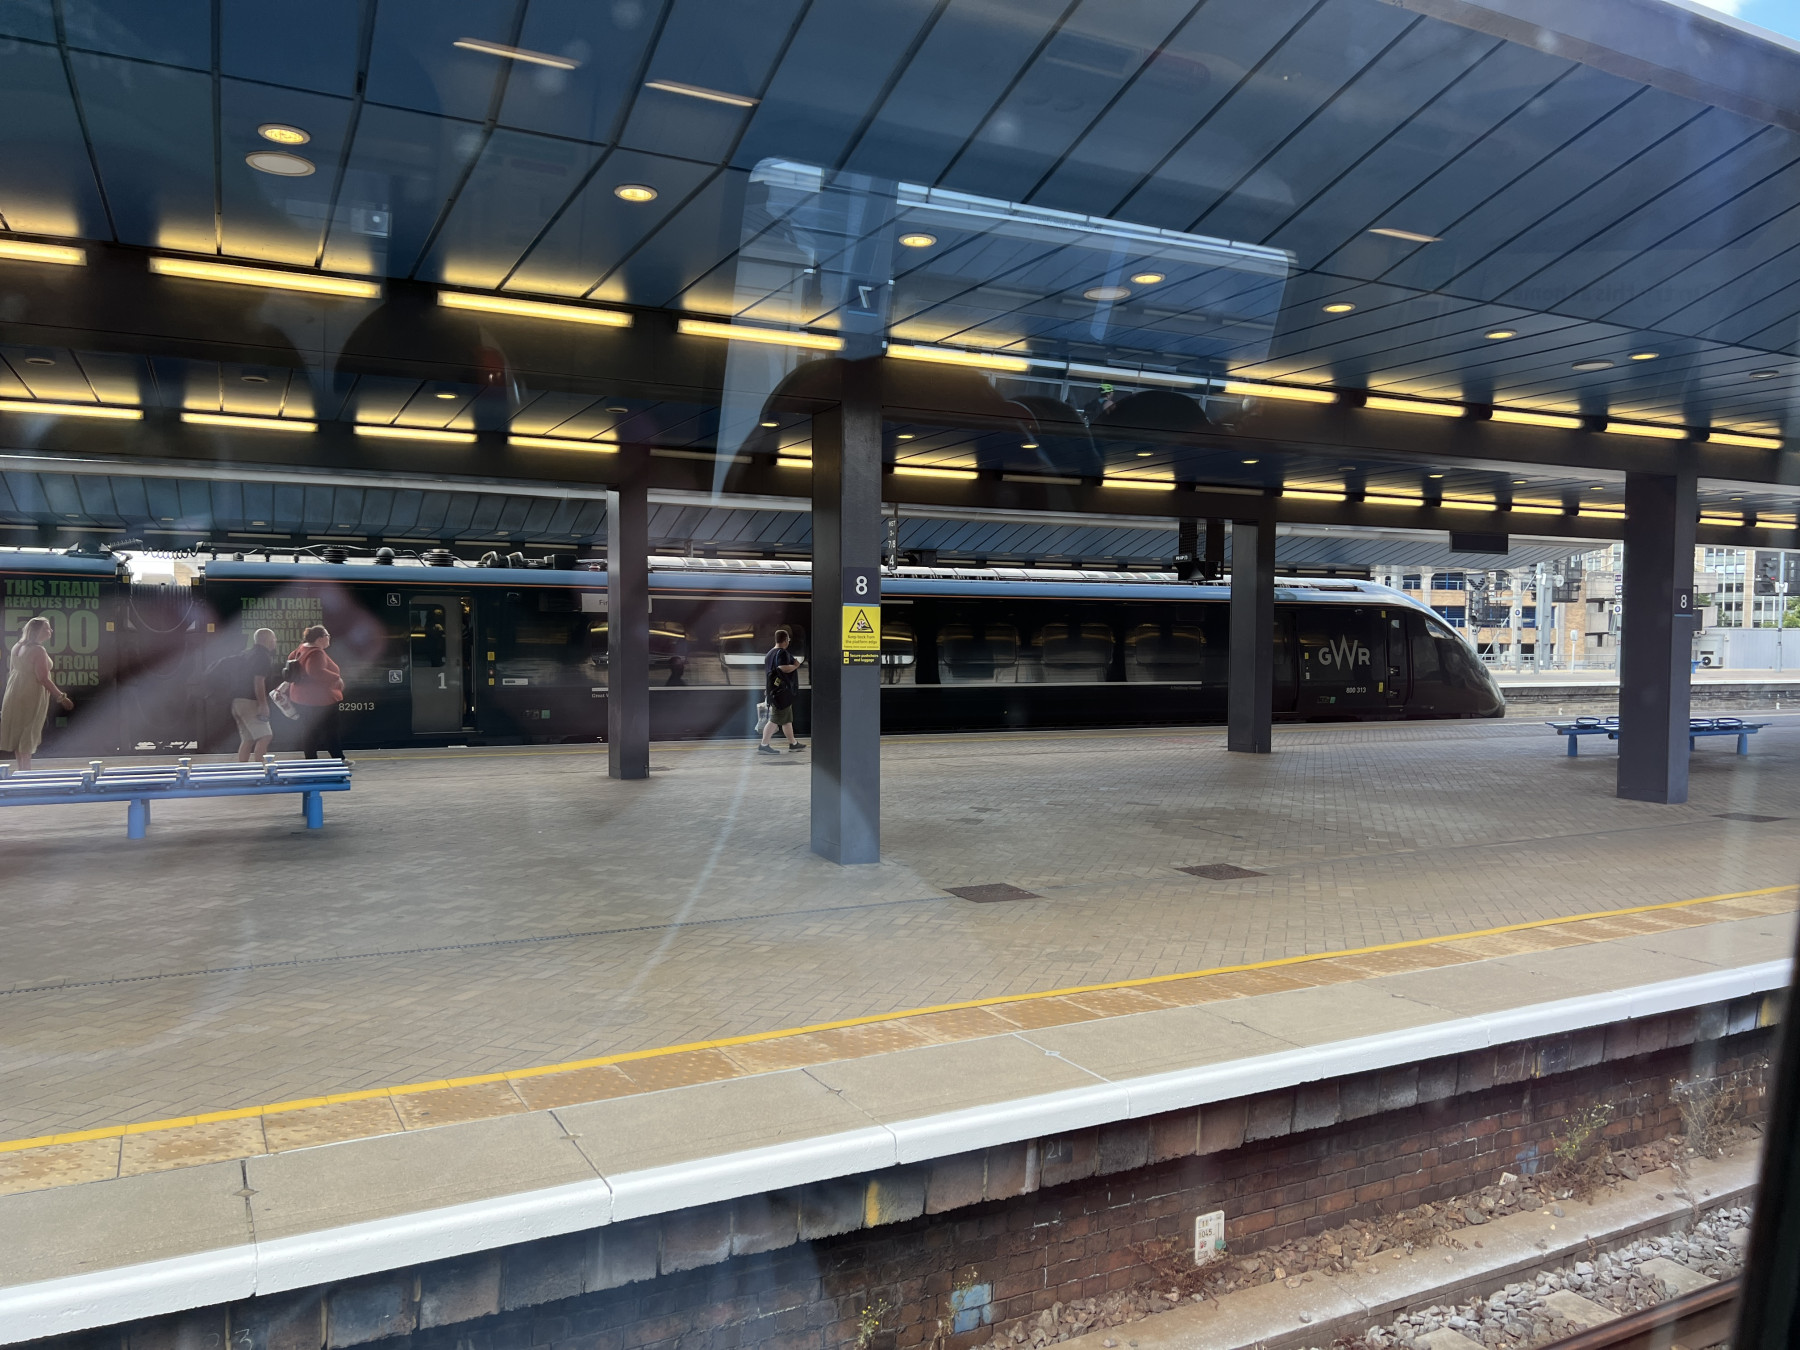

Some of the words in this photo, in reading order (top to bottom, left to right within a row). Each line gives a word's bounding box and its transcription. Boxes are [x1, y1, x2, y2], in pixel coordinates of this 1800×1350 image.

[889, 554, 895, 566] 4
[4, 579, 45, 596] THIS
[48, 580, 99, 597] TRAIN
[855, 575, 868, 595] 8
[4, 596, 62, 609] REMOVES
[65, 598, 82, 609] UP
[84, 598, 99, 609] TO
[240, 597, 278, 610] TRAIN
[279, 598, 323, 610] TRAVEL
[1680, 594, 1688, 609] 8
[241, 610, 284, 620] REDUCES
[285, 610, 323, 620] CARBON
[1318, 634, 1370, 671] GWR
[54, 655, 99, 670] FROM
[437, 672, 447, 689] 1
[338, 702, 375, 712] 829013
